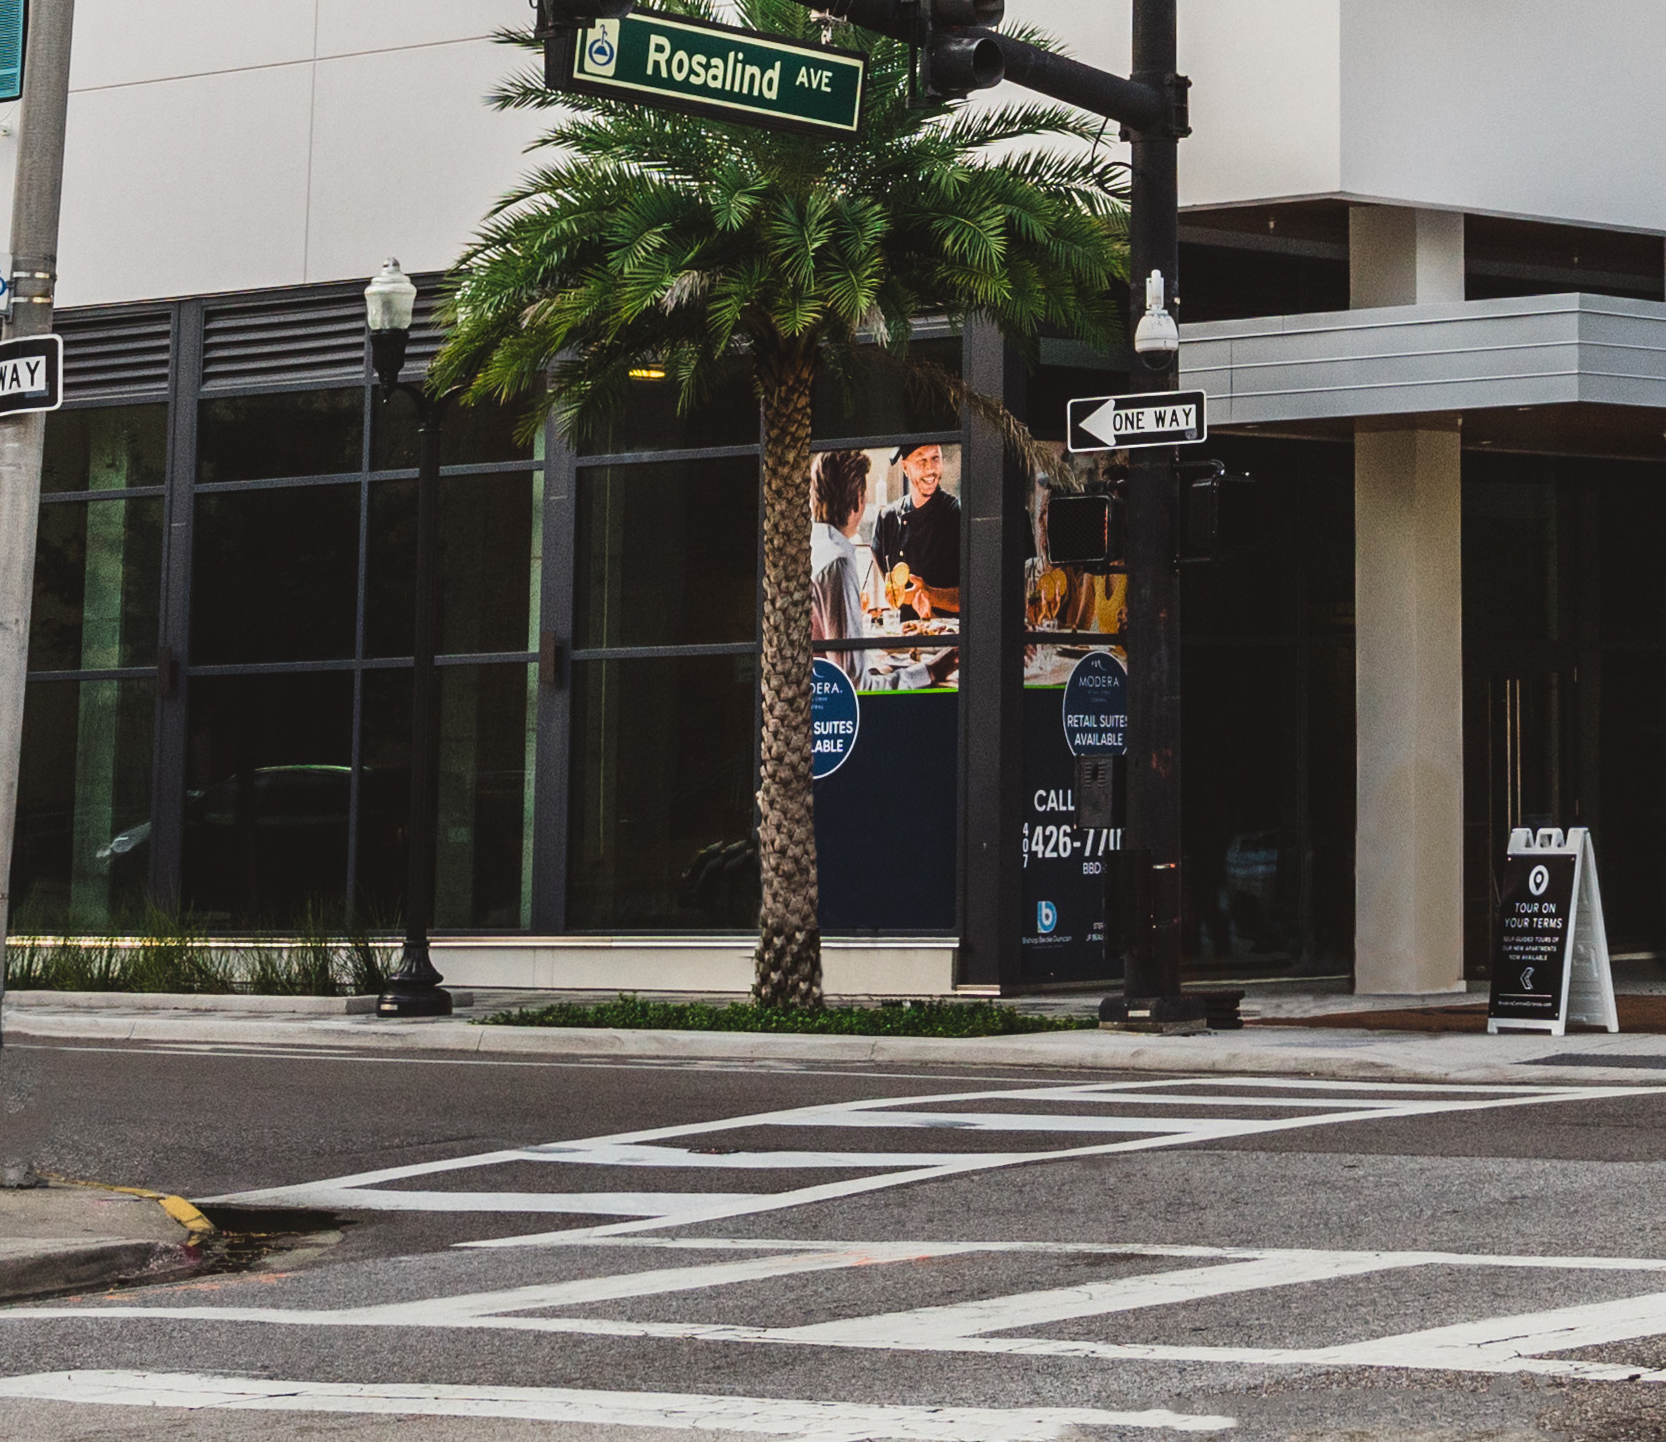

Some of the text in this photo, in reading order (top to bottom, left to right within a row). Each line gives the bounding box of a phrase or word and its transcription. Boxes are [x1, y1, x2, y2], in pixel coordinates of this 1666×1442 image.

[646, 33, 834, 101] Rosalind AVE
[1113, 407, 1192, 432] ONE WAY
[1079, 676, 1119, 687] MODERA
[1067, 715, 1098, 727] RETAIL
[814, 720, 854, 735] SUITES
[1074, 733, 1123, 746] AVAILABLE
[1034, 789, 1075, 812] CALL
[1083, 862, 1102, 874] BBD
[1515, 902, 1556, 913] TOUR ON
[1505, 917, 1563, 929] YOUR TERMS
